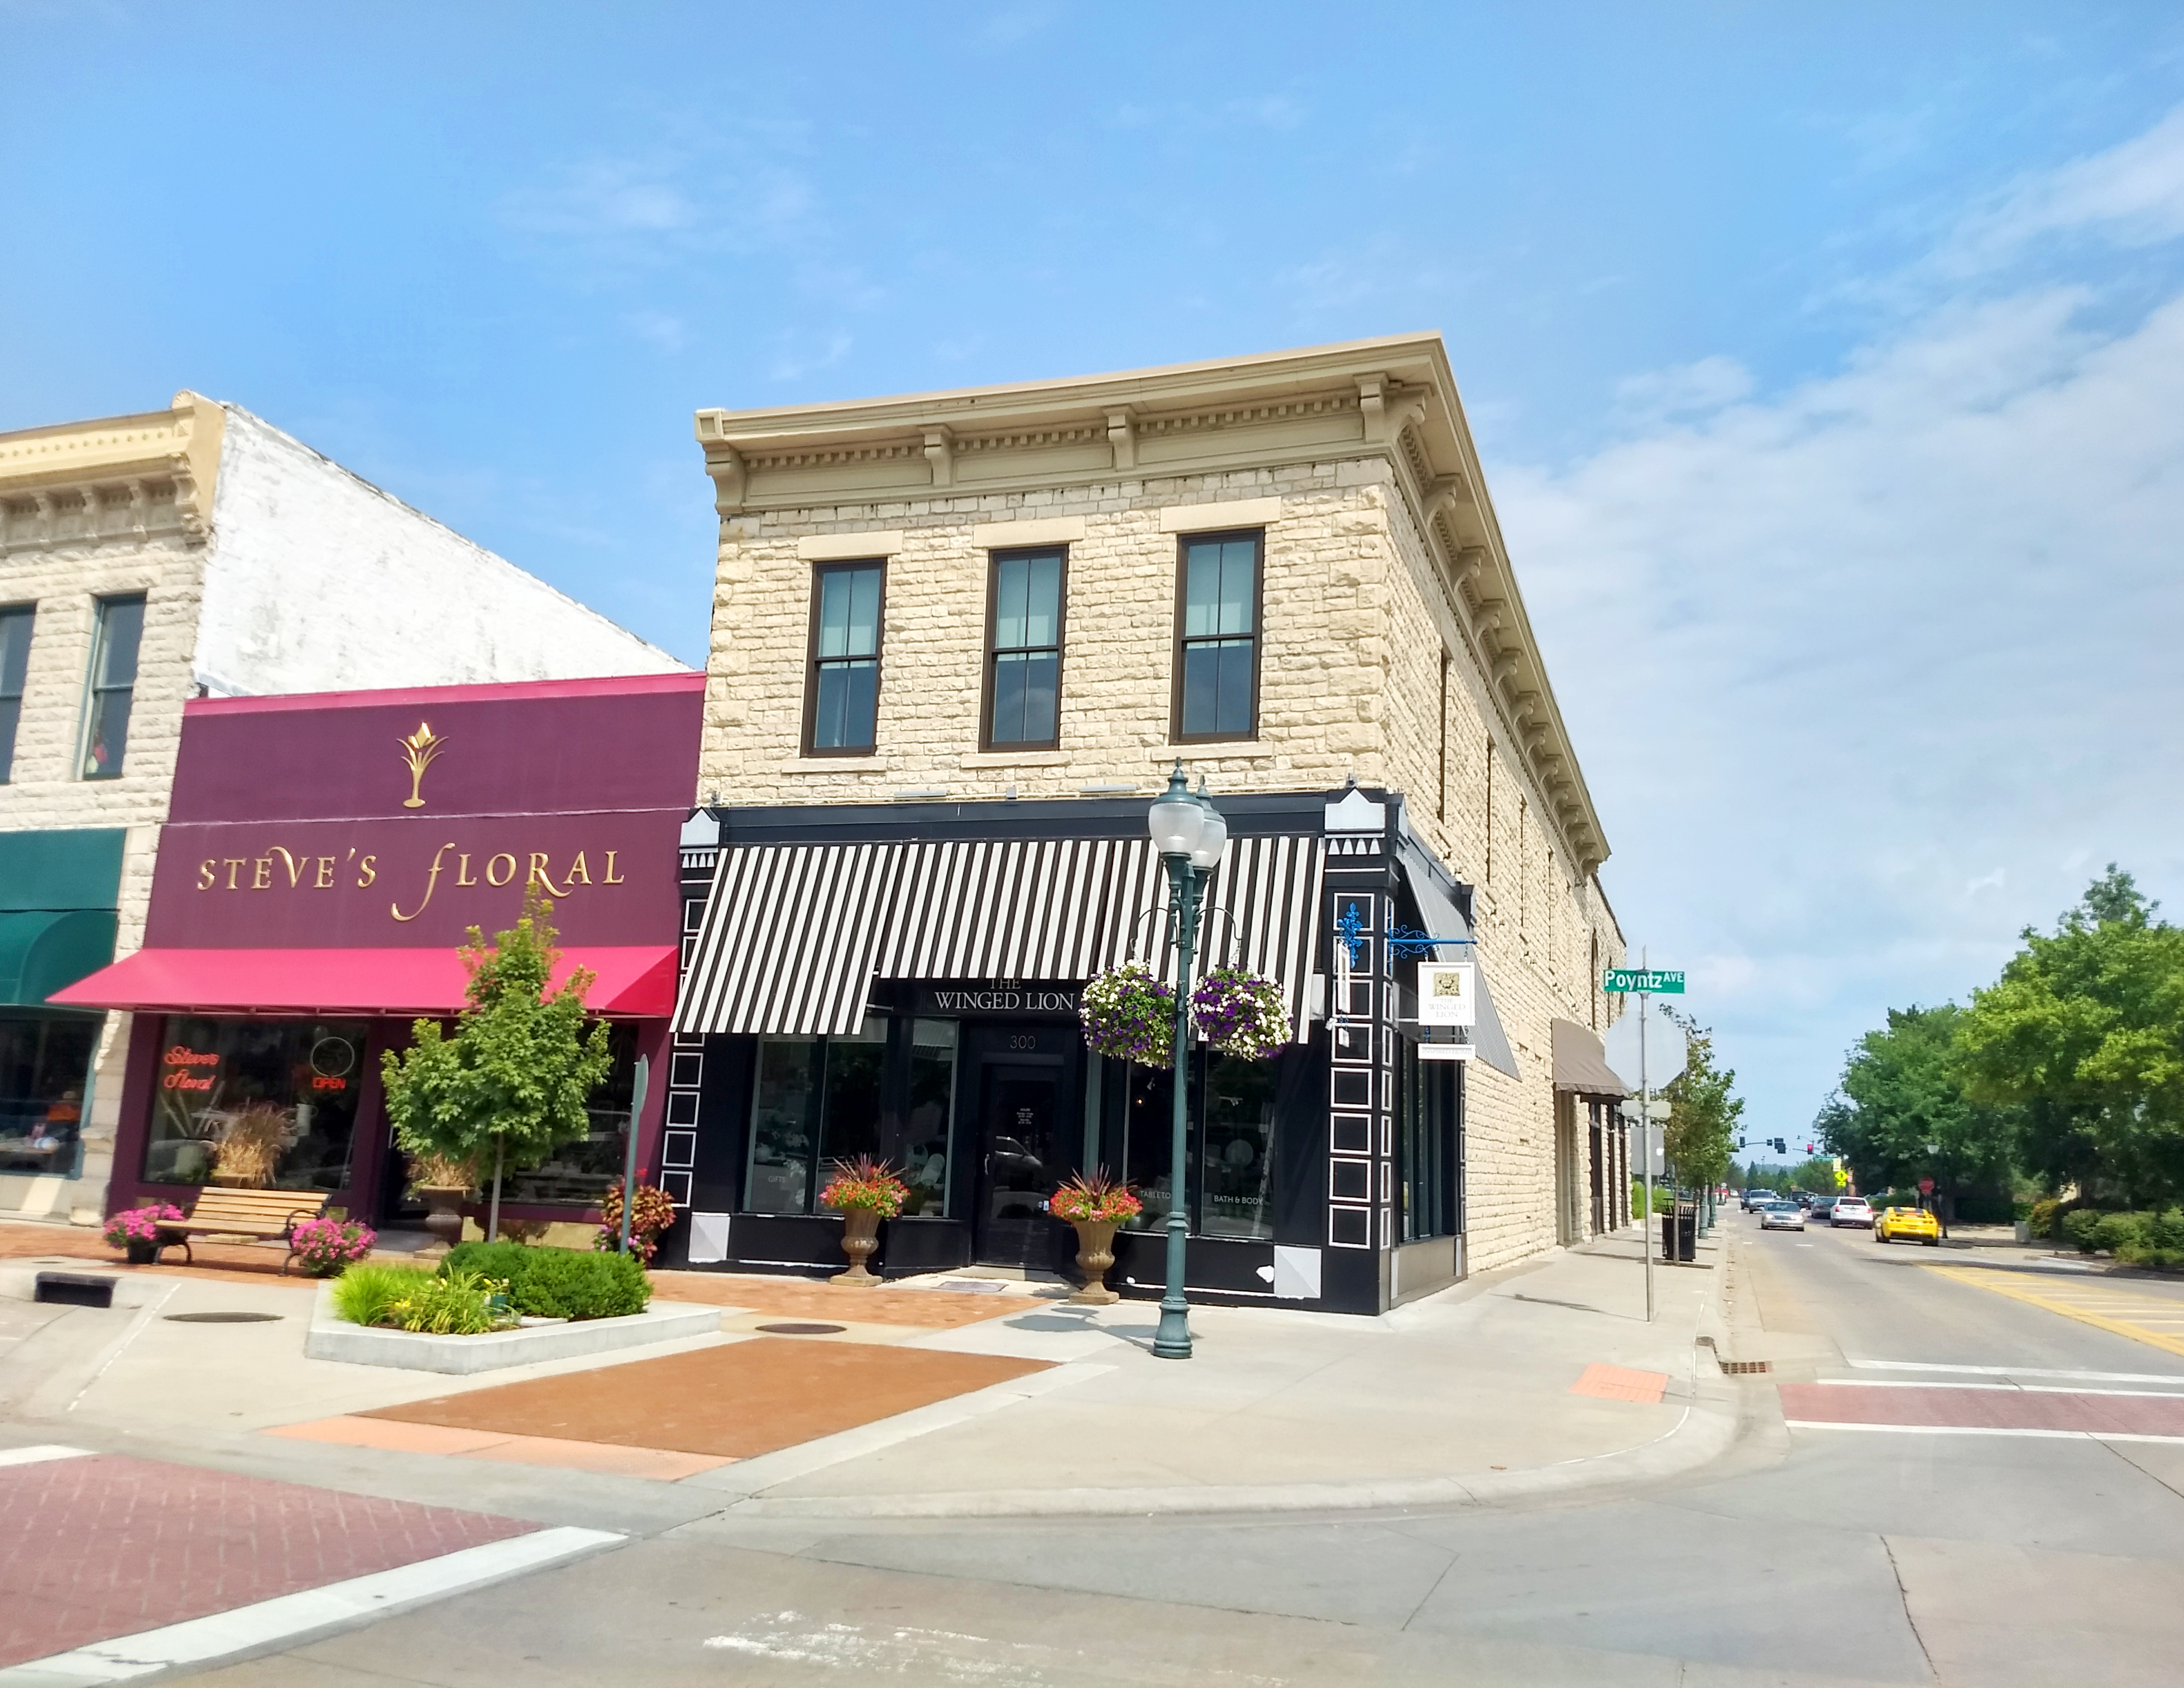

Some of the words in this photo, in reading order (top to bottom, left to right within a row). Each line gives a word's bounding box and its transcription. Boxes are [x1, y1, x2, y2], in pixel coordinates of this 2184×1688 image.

[197, 846, 377, 891] STEVE'S
[990, 979, 1021, 989] THE
[1605, 970, 1663, 991] Poyntz
[1663, 972, 1684, 983] AVE
[935, 991, 1020, 1010] WINGED
[1025, 992, 1075, 1010] LION
[1010, 1035, 1036, 1049] 300
[313, 1077, 346, 1088] OPEN
[1140, 1190, 1171, 1199] TABLETO
[1242, 1197, 1263, 1205] BODY
